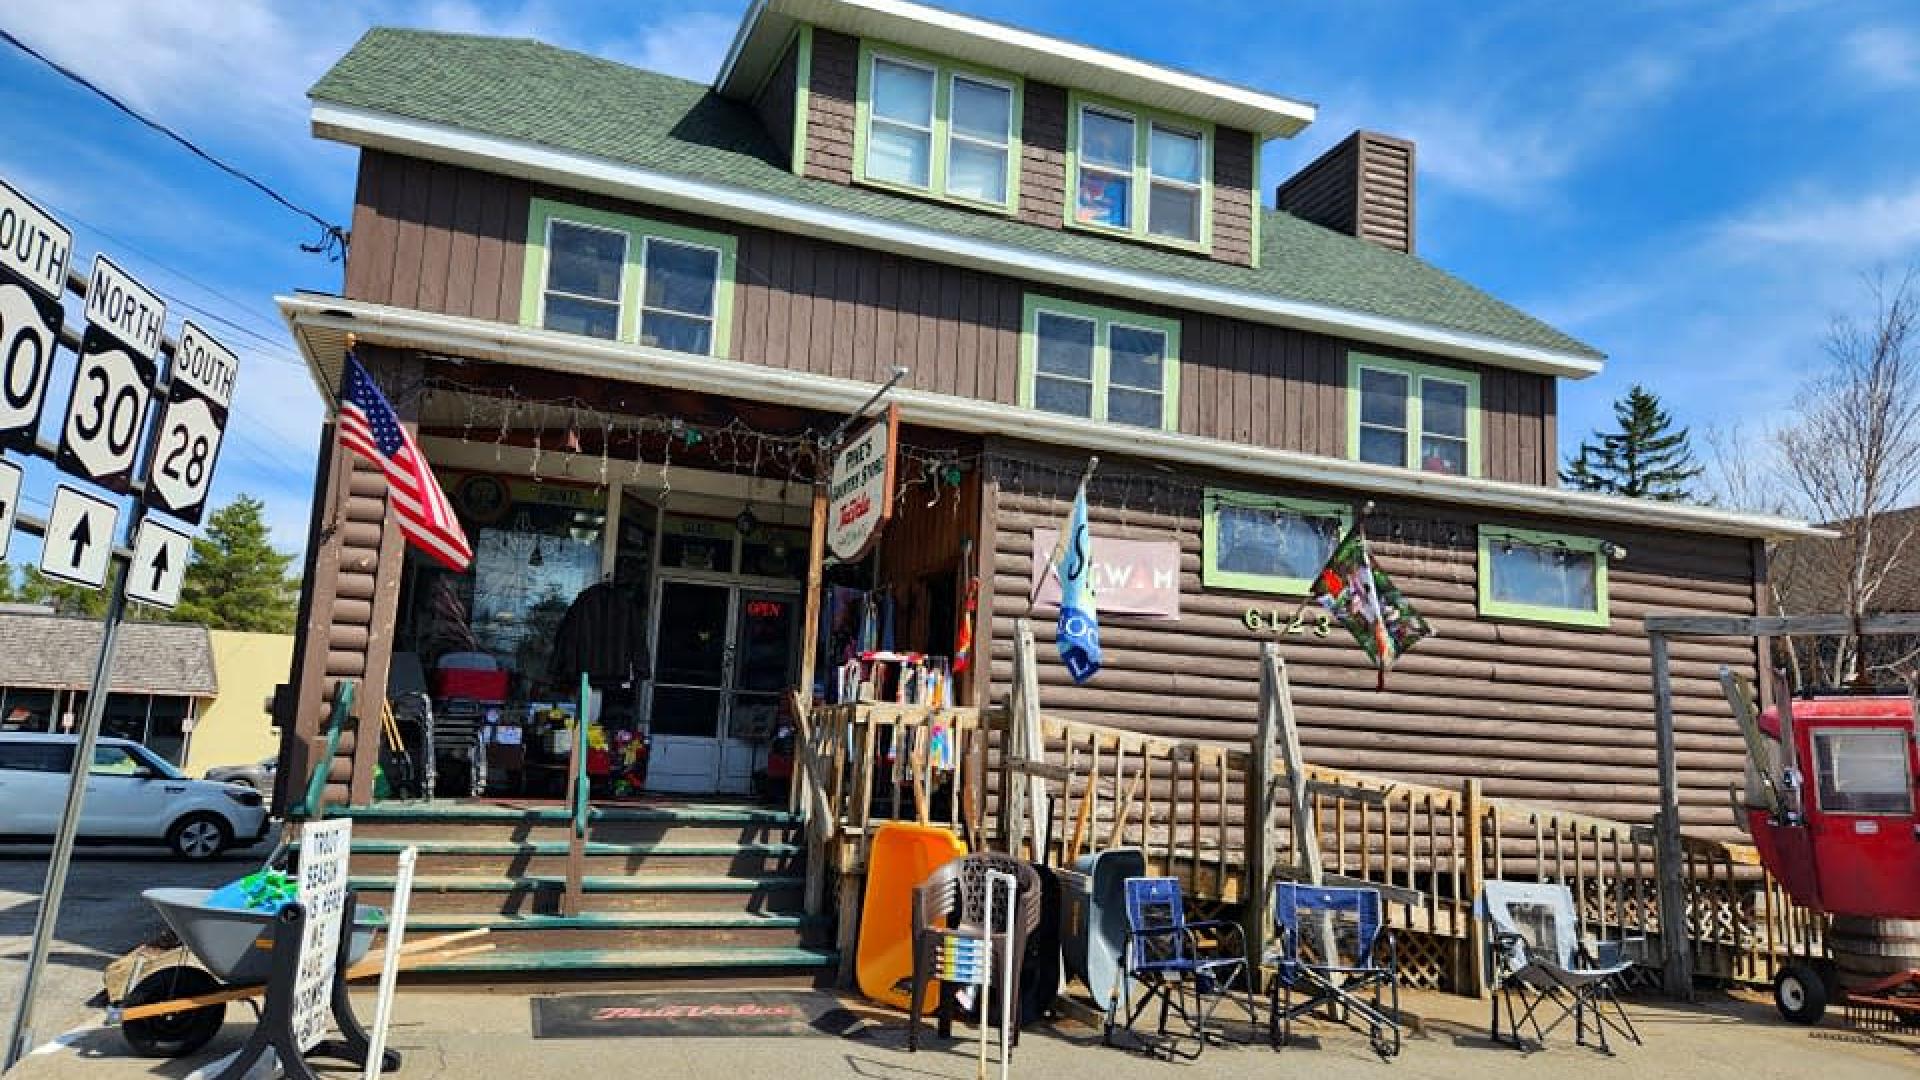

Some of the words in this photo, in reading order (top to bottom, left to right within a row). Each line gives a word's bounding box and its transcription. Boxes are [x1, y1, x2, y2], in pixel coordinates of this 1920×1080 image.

[0, 208, 66, 285] OUTH
[91, 270, 161, 350] NORTH
[0, 312, 42, 410] 0
[179, 335, 236, 400] SOUTH
[76, 366, 138, 456] 30
[162, 424, 208, 486] 28
[748, 601, 781, 617] OPEN
[1245, 607, 1331, 637] 6123
[306, 859, 337, 890] SEASON
